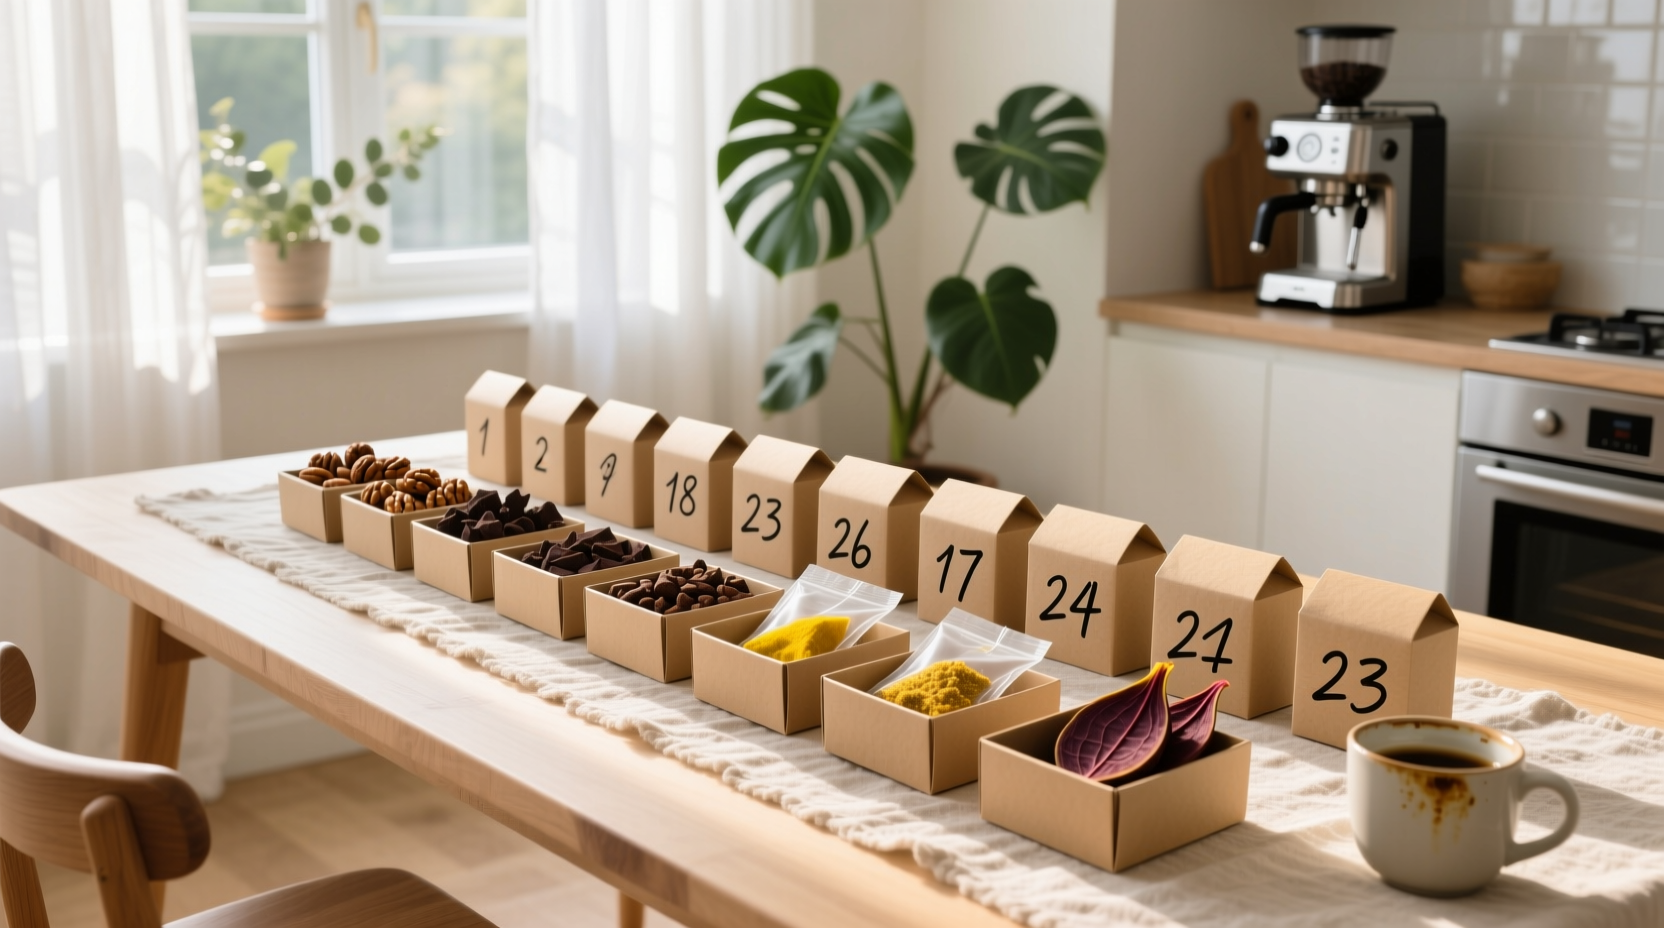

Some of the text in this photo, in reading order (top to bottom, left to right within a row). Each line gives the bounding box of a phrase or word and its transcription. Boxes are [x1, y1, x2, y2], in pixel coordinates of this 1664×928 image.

[479, 417, 490, 456] 1
[533, 436, 549, 473] 2
[665, 471, 698, 517] 18
[740, 493, 782, 542] 23
[827, 517, 872, 570] 26
[936, 543, 984, 603] 17
[1038, 574, 1102, 639] 24
[1311, 649, 1388, 715] 23
